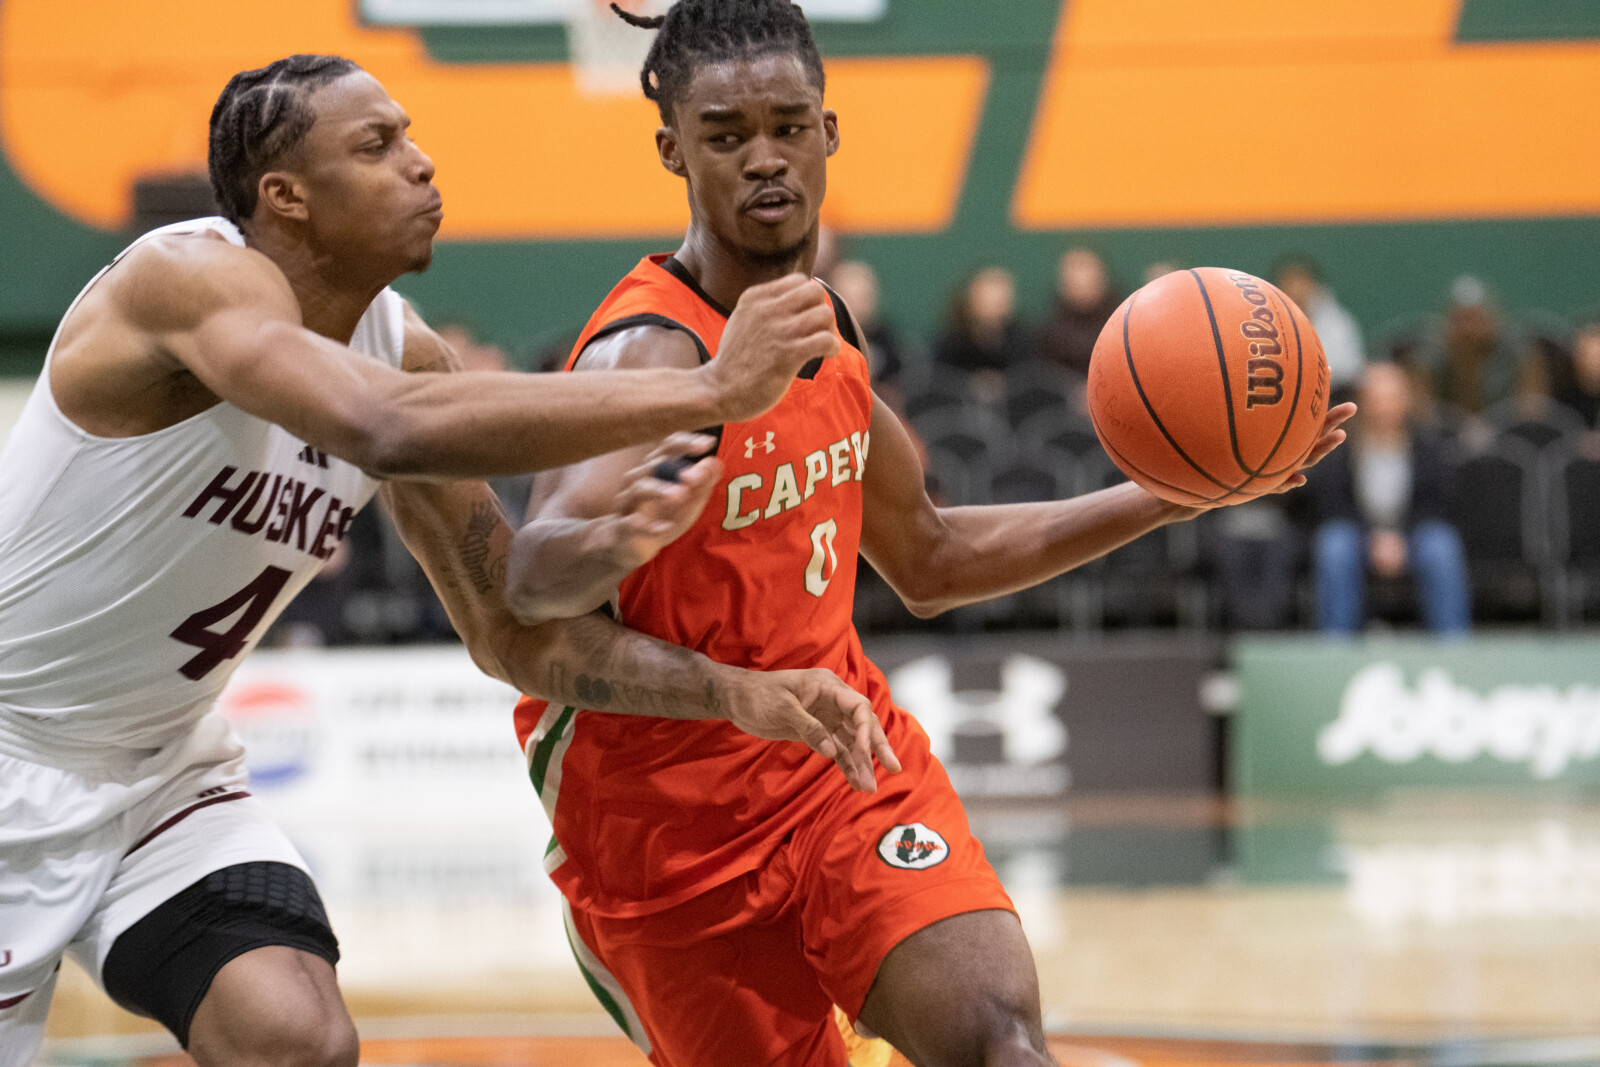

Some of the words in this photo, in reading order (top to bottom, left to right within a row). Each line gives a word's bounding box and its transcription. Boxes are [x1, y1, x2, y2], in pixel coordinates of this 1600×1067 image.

[1229, 272, 1284, 411] Wilson
[804, 517, 838, 598] 0
[168, 564, 294, 681] 4
